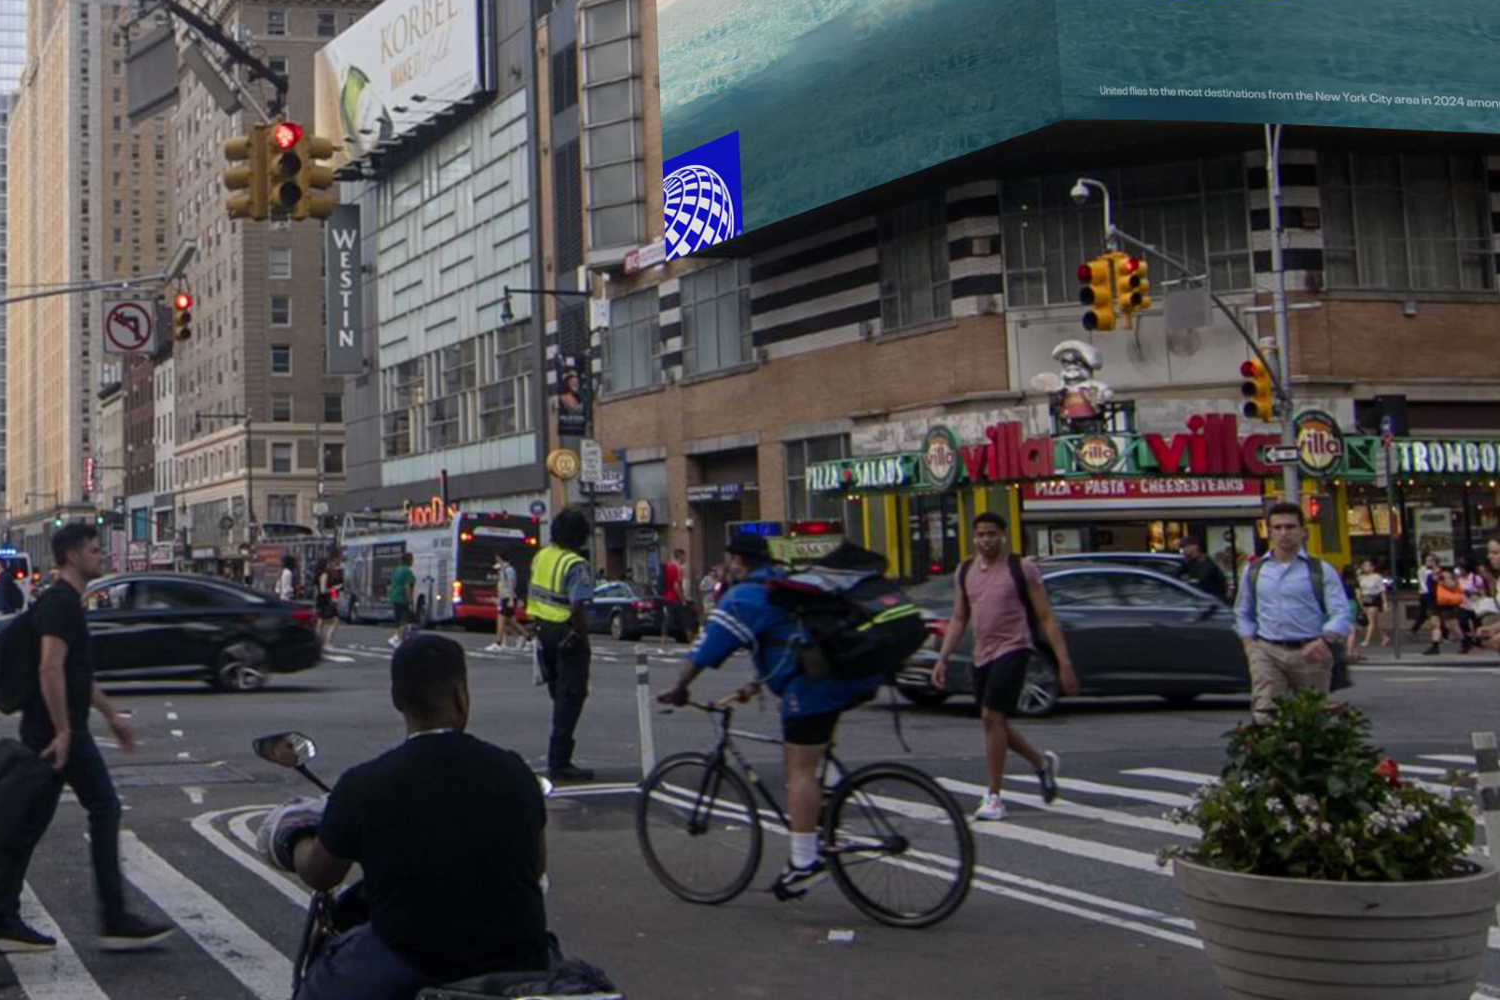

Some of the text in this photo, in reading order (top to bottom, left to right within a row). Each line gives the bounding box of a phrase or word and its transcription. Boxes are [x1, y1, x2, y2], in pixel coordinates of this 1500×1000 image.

[1099, 86, 1500, 109] United flies to the most destinations from the New York City area in 2024 amon
[332, 228, 357, 347] WESTIN
[921, 446, 957, 467] villa
[959, 420, 1055, 482] villa
[1076, 439, 1117, 460] villa
[1390, 441, 1500, 473] TROMBO
[805, 455, 904, 491] PIZZA SALADS
[1035, 477, 1245, 497] PIZZA PASTA CHEESESTEAKS
